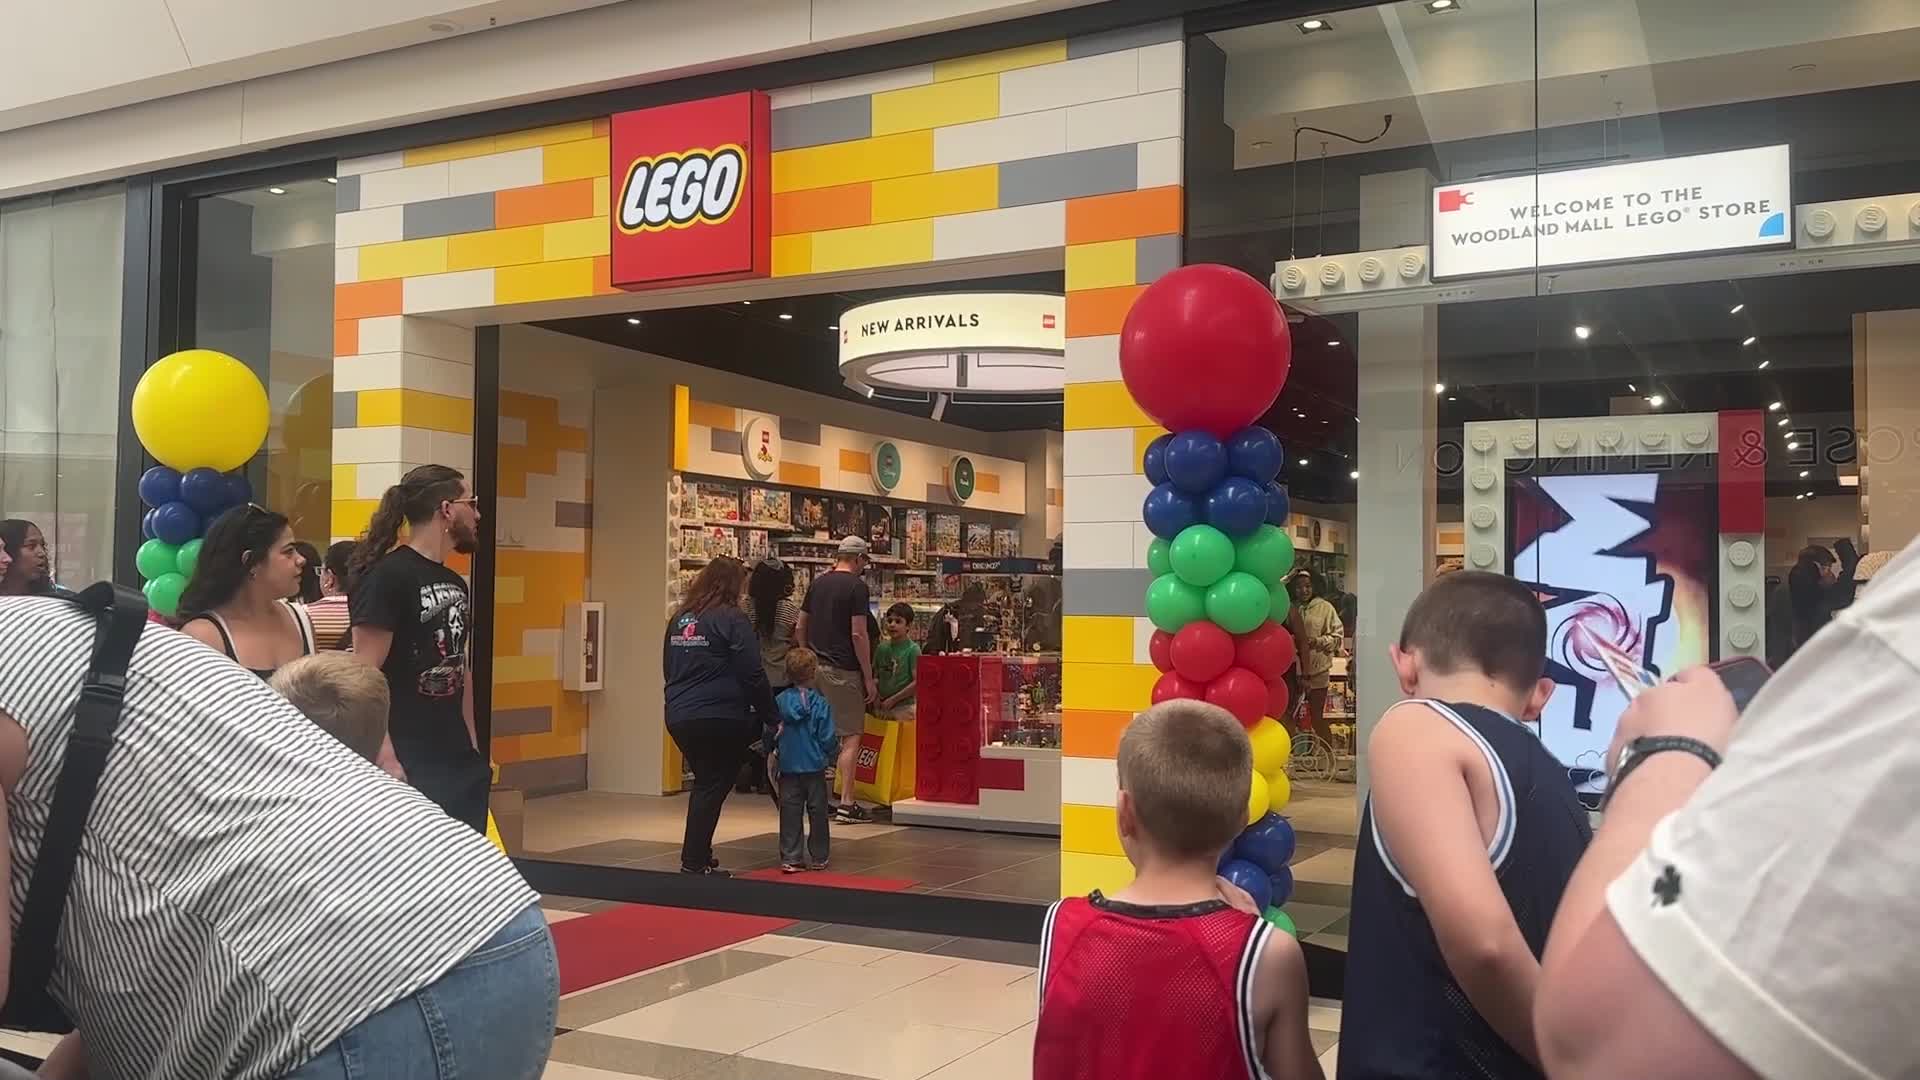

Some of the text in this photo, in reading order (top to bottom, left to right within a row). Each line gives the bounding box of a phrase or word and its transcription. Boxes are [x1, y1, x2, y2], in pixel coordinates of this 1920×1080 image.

[618, 147, 745, 231] LEGO
[1509, 186, 1704, 221] WELCOME TO THE
[1451, 222, 1560, 247] WOODLAND
[1565, 216, 1614, 235] MALL
[1698, 199, 1772, 221] STORE
[861, 319, 890, 337] NEW
[894, 313, 980, 332] ARRIVALS
